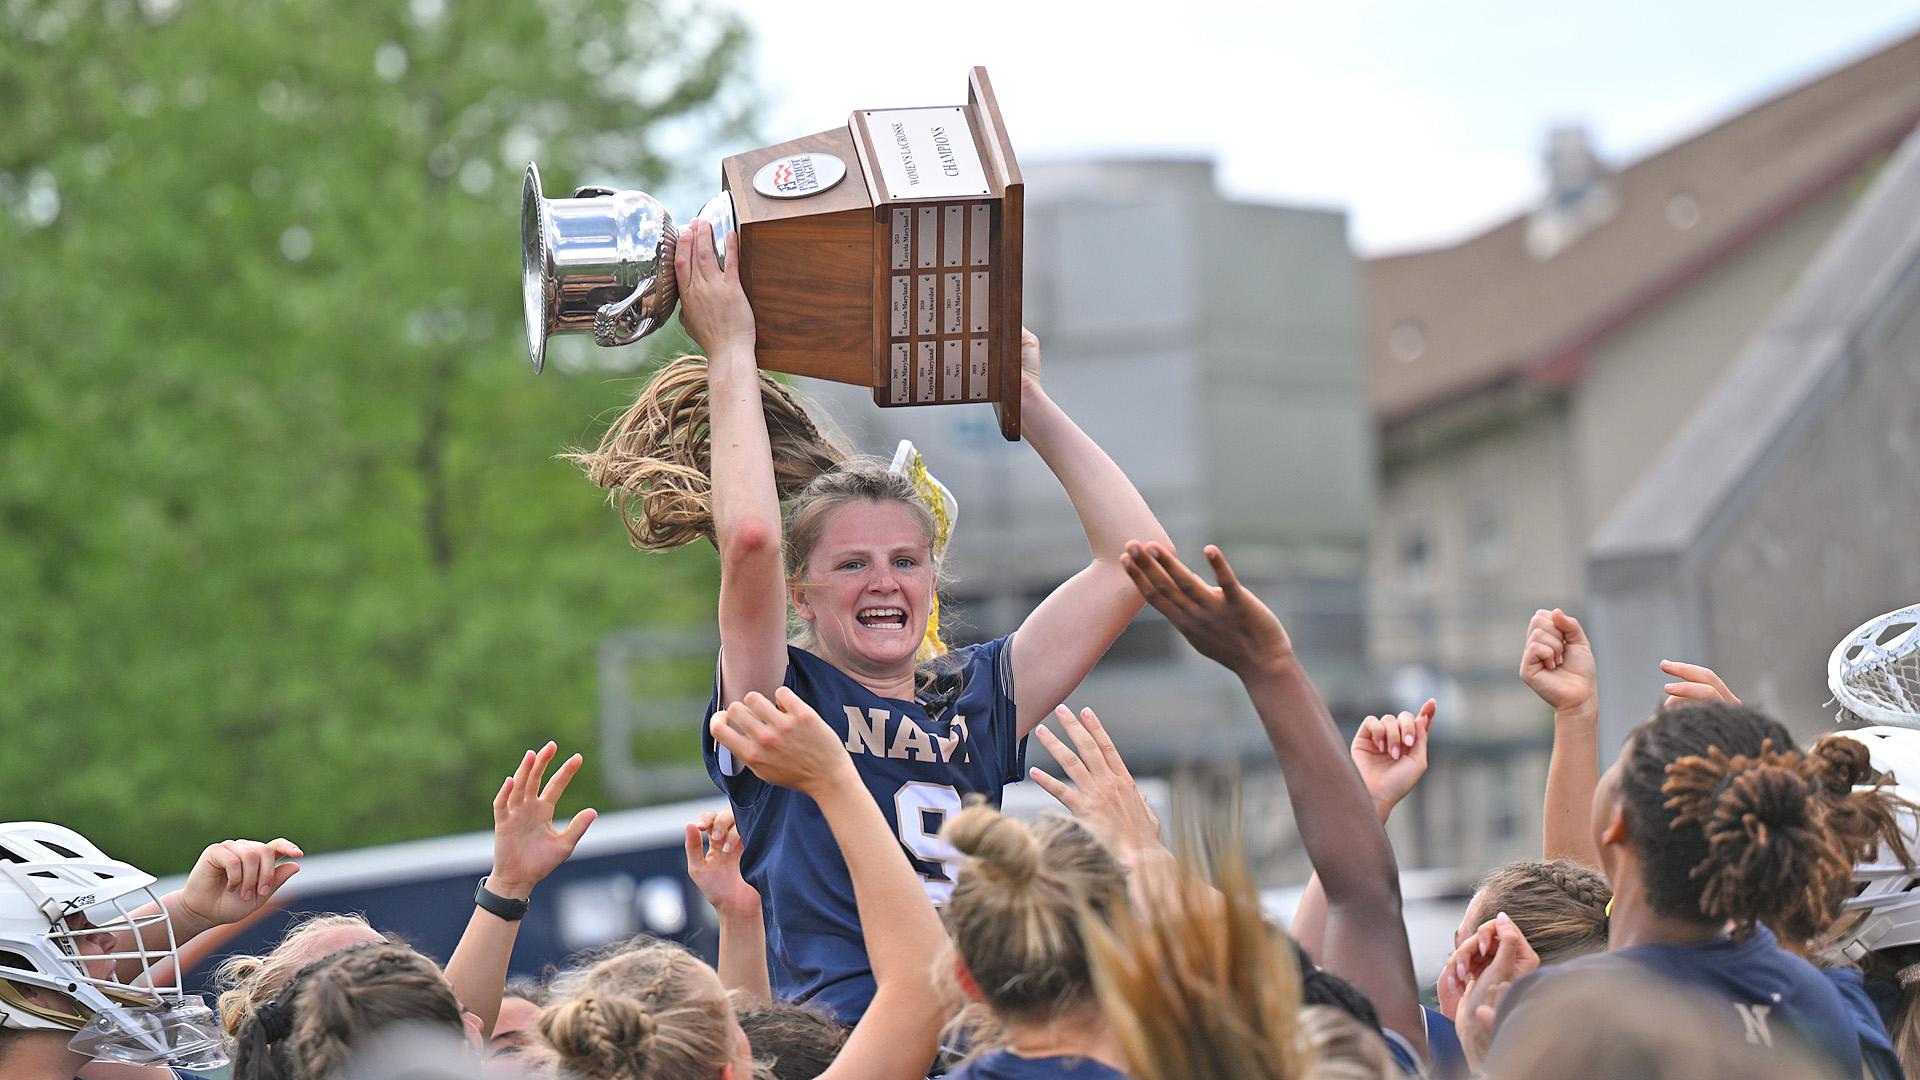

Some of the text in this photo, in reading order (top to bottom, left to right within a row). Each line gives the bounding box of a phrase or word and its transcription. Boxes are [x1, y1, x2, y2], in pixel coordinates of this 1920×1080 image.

[892, 122, 911, 155] LACROSSE
[931, 126, 959, 177] CHAMPIONS
[791, 159, 808, 191] PATRIOT
[801, 156, 818, 189] LEAGUE
[954, 280, 962, 307] Maryland
[901, 350, 909, 376] Maryland
[927, 349, 935, 376] Maryland
[894, 780, 963, 907] 9
[1733, 1002, 1774, 1048] N
